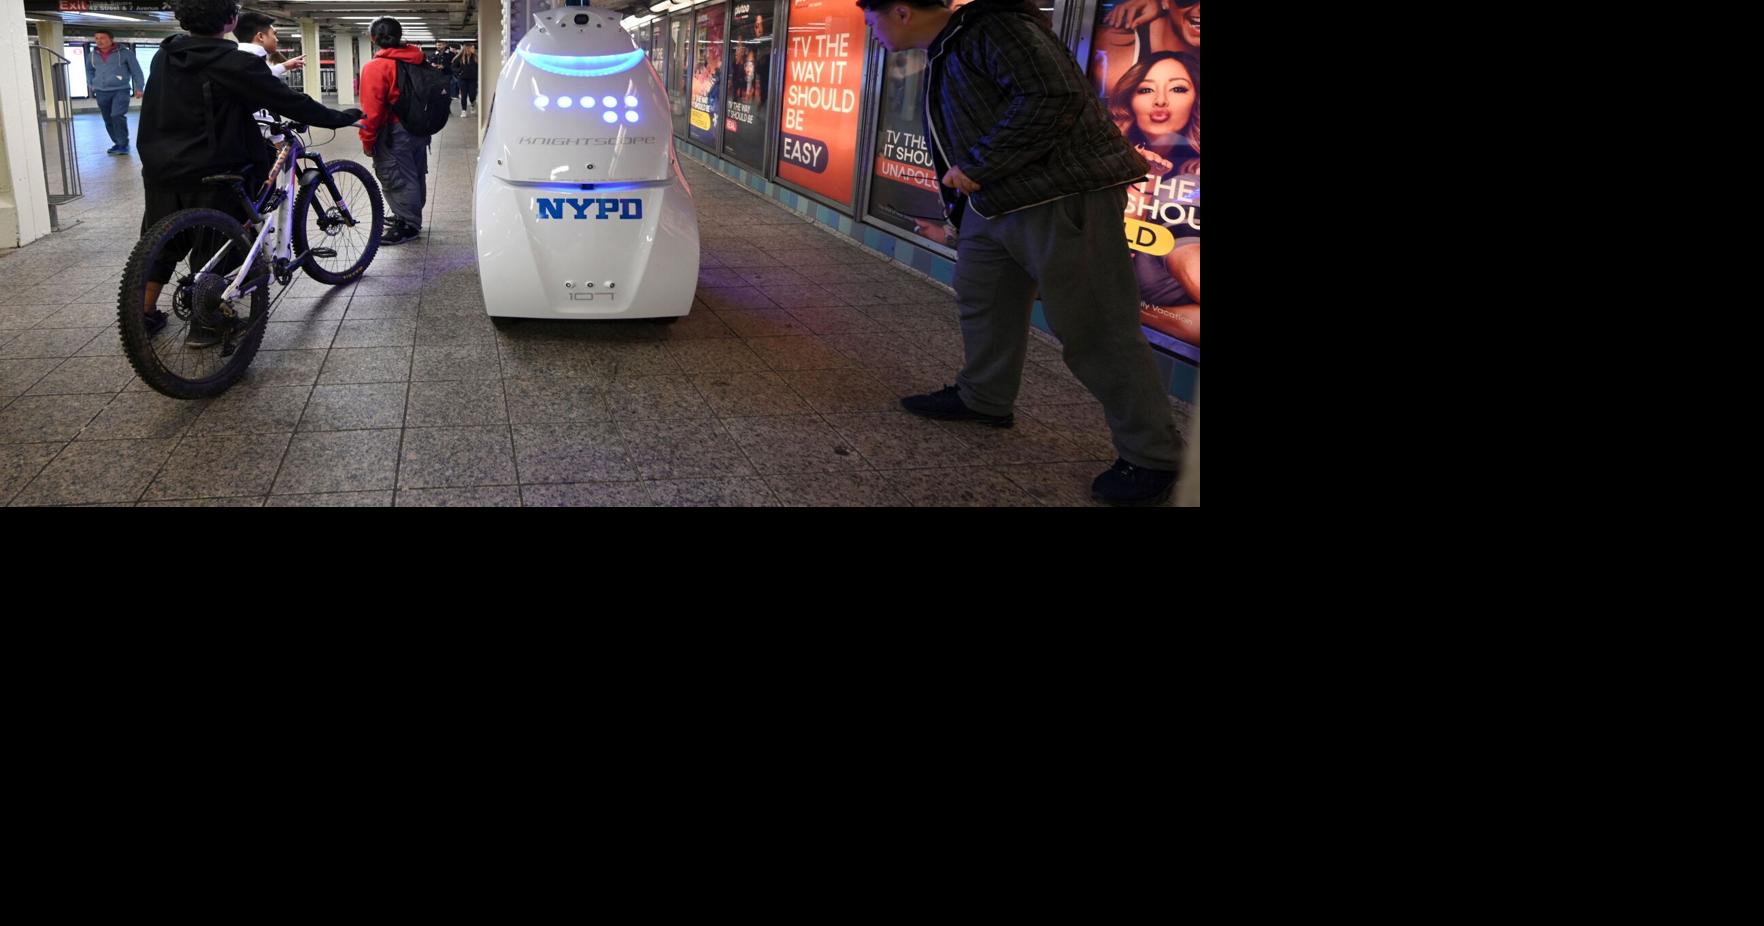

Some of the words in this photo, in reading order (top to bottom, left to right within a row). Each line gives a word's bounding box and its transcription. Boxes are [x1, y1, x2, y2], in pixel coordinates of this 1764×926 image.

[60, 0, 87, 11] Exit
[793, 36, 811, 58] TV
[816, 33, 850, 58] THE
[791, 61, 825, 84] WAY
[830, 61, 847, 85] IT
[788, 85, 855, 114] SHOULD
[785, 108, 804, 131] BE
[519, 136, 657, 146] KNIGHTSCOPE
[886, 129, 901, 144] TV
[904, 132, 928, 150] THE
[783, 138, 822, 168] EASY
[883, 144, 894, 158] IT
[896, 147, 933, 167] SHOU
[1139, 173, 1196, 204] THE
[536, 198, 643, 220] NYPD
[569, 292, 615, 301] 107
[1152, 303, 1194, 327] Vacation
